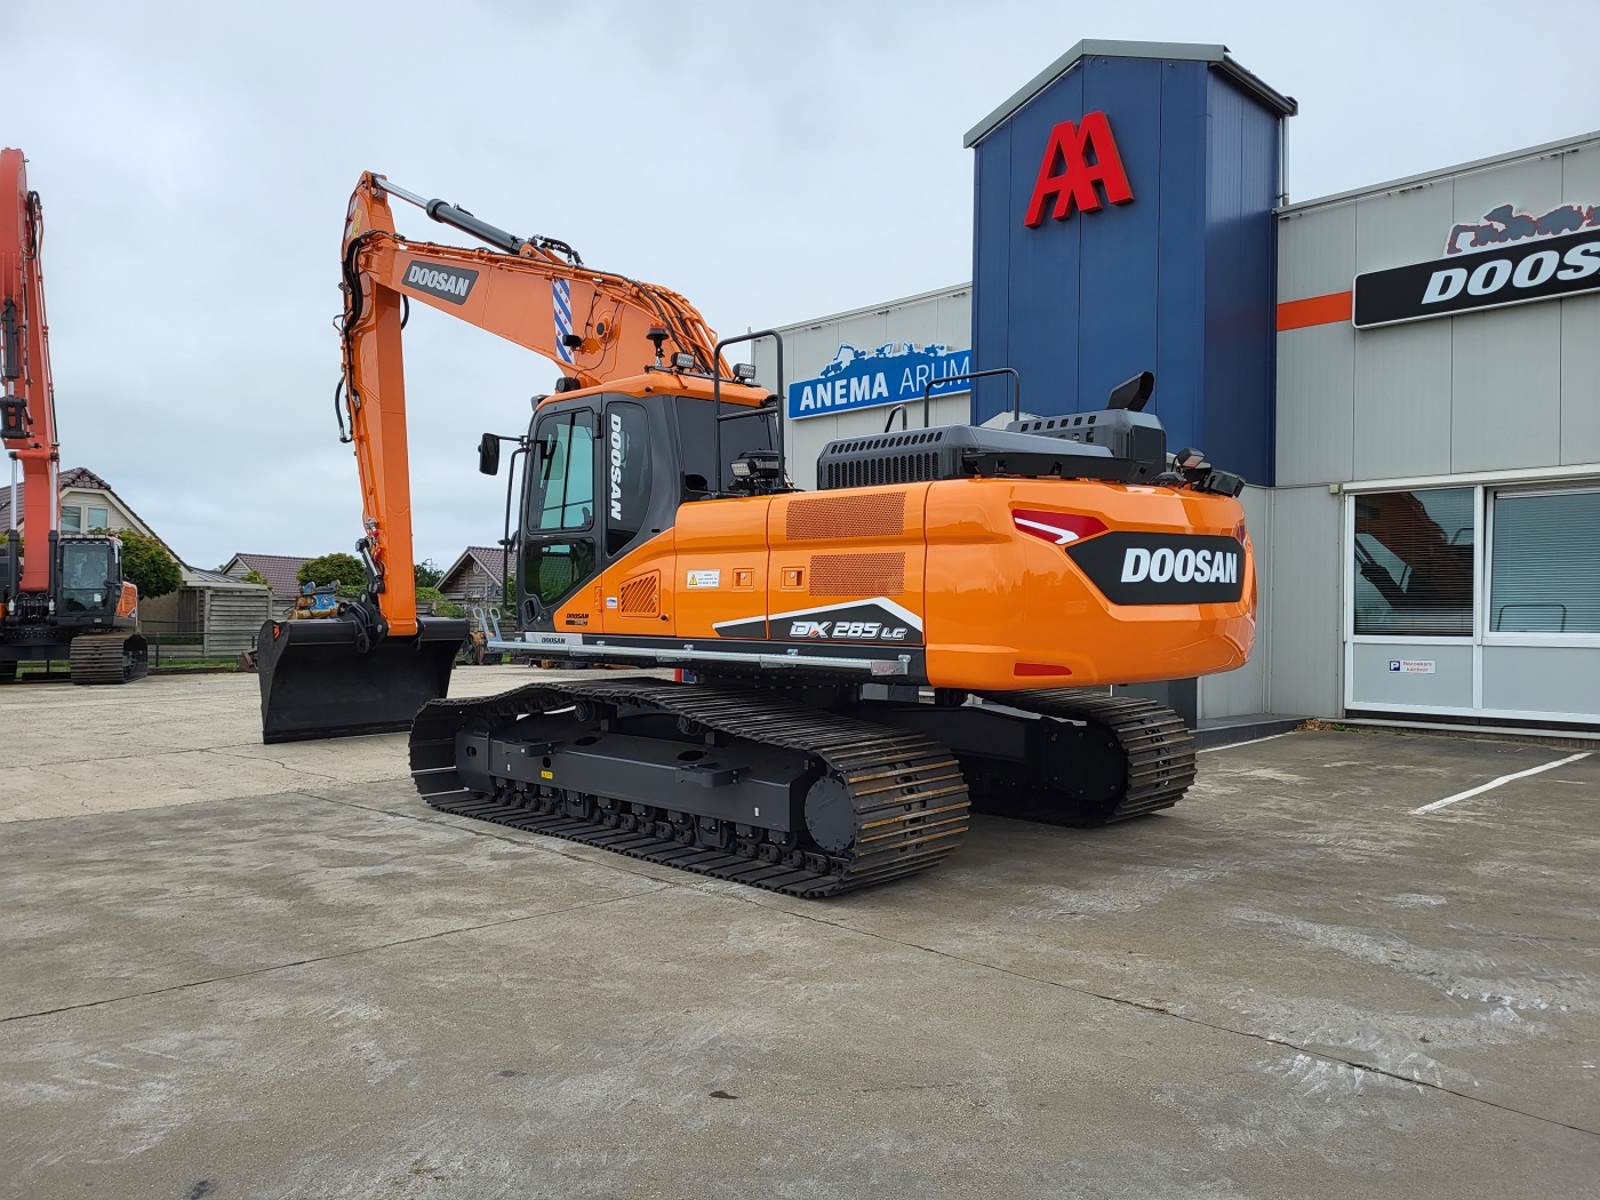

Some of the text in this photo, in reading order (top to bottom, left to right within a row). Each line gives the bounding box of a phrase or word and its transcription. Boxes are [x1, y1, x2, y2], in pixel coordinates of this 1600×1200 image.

[408, 265, 470, 297] DOOSAN
[1421, 241, 1600, 305] DOOS
[800, 356, 971, 411] ANEMA ARUM
[611, 413, 622, 521] DOOSAN
[1120, 548, 1237, 584] DOOSAN
[790, 621, 832, 638] DX
[832, 622, 882, 639] 285
[1390, 661, 1400, 671] P
